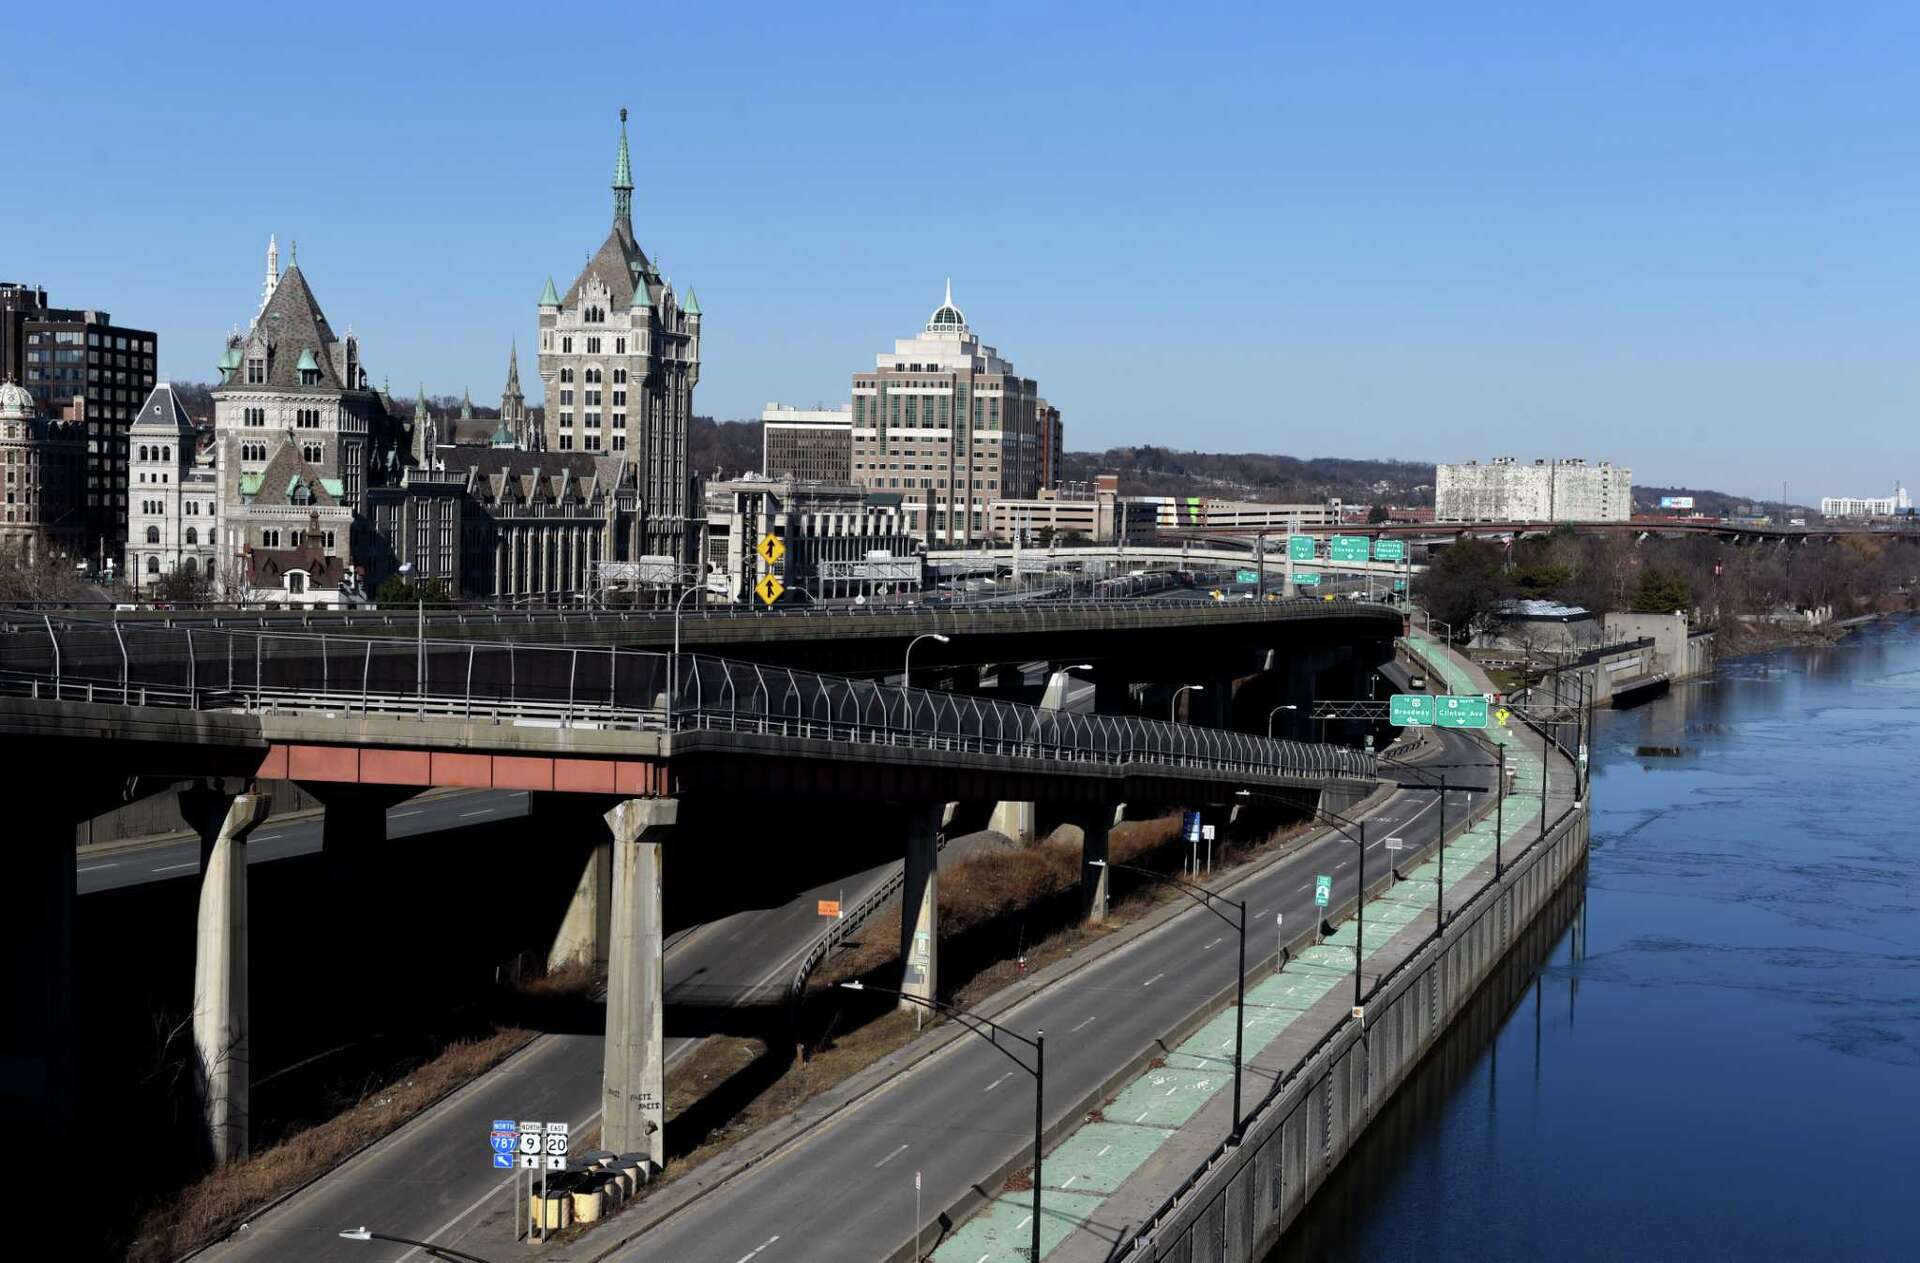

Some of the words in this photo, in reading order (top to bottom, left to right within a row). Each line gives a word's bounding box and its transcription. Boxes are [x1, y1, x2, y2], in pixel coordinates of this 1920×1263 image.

[1394, 709, 1430, 717] Broadway
[1439, 709, 1466, 717] Clinton
[494, 1137, 515, 1149] 787
[526, 1138, 535, 1149] 9
[548, 1139, 566, 1151] 20
